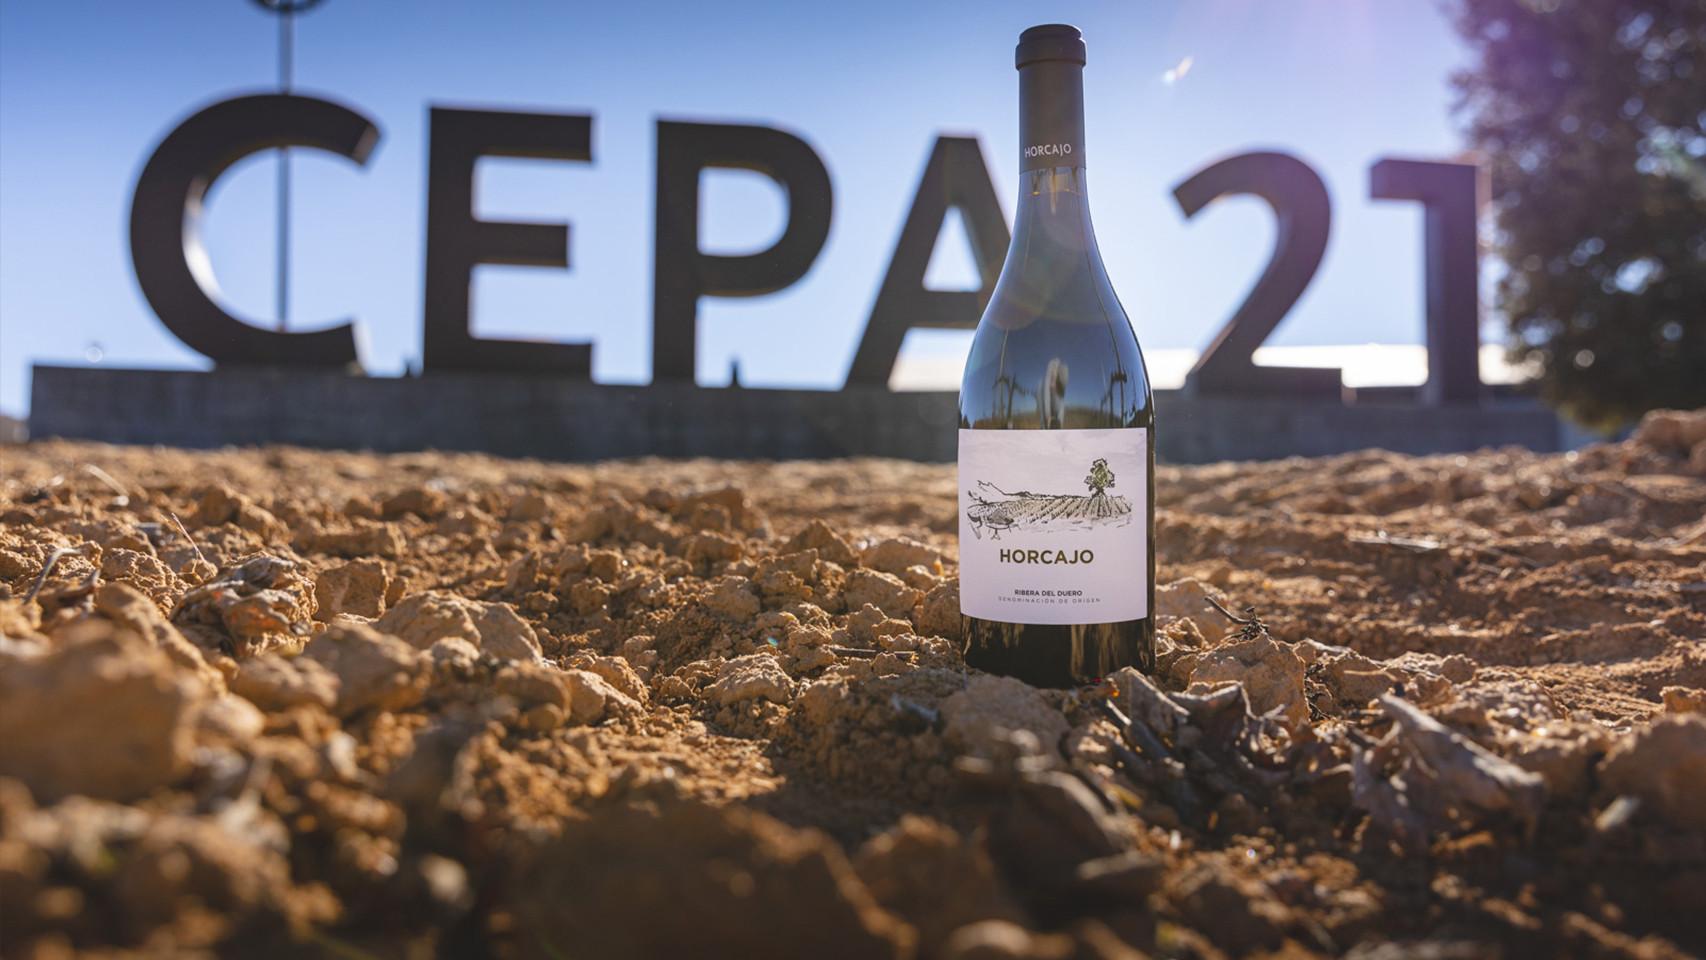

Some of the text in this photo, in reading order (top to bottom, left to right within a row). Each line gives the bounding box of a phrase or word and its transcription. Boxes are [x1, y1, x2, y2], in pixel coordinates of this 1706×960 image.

[1024, 143, 1072, 158] HORCAJO
[129, 92, 1488, 402] CEPA 21
[1000, 549, 1094, 564] HORCAJO
